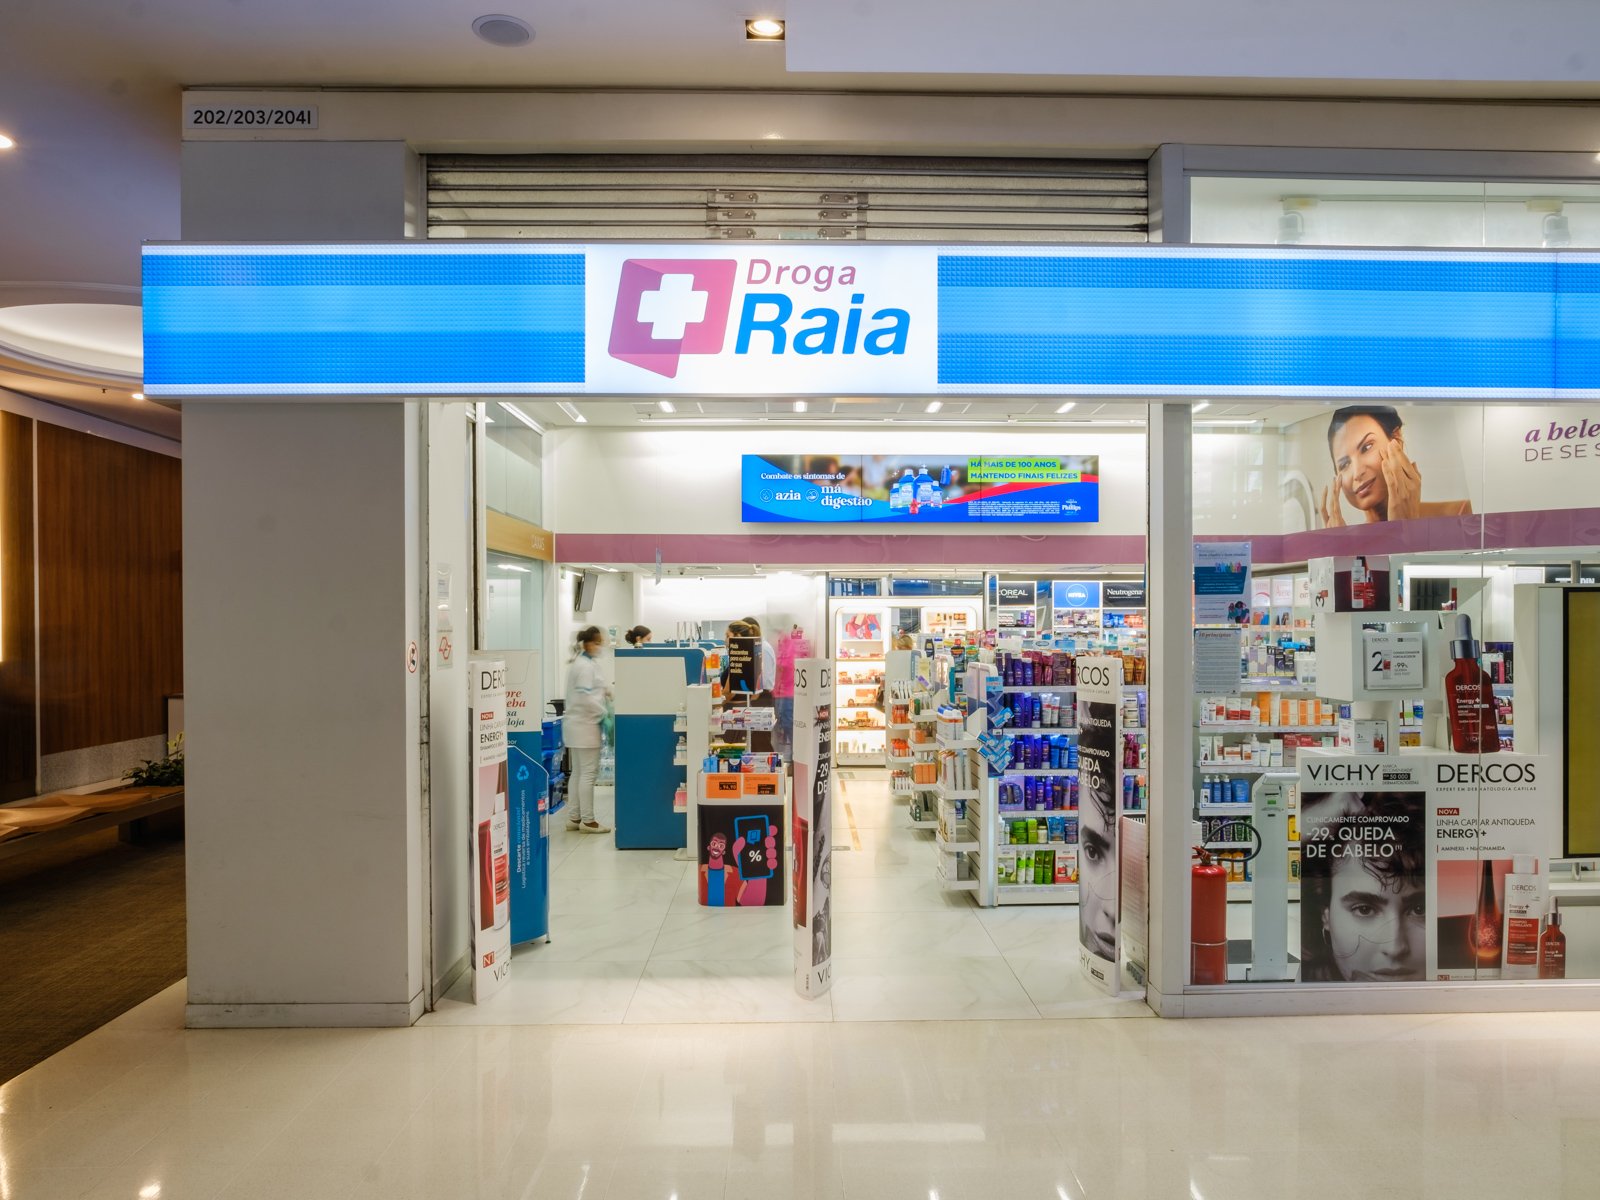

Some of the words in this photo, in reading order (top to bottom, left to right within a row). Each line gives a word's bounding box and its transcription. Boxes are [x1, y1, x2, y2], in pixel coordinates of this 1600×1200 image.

[746, 258, 857, 293] Droga
[734, 293, 911, 356] Raia
[1524, 429, 1541, 443] a
[1525, 446, 1553, 462] DE
[970, 460, 982, 468] HÁ
[760, 472, 793, 480] Combate
[802, 472, 835, 480] sintomas
[836, 472, 845, 480] de
[775, 489, 801, 501] azia
[821, 484, 841, 494] má
[821, 495, 872, 509] digestão
[1307, 764, 1380, 781] VICHY
[1437, 763, 1536, 783] DERCOS
[1436, 819, 1459, 827] LINHA
[1491, 818, 1536, 826] ANTIQUEDA
[1339, 826, 1395, 841] QUEDA
[748, 850, 762, 862] %
[1307, 844, 1326, 858] DE
